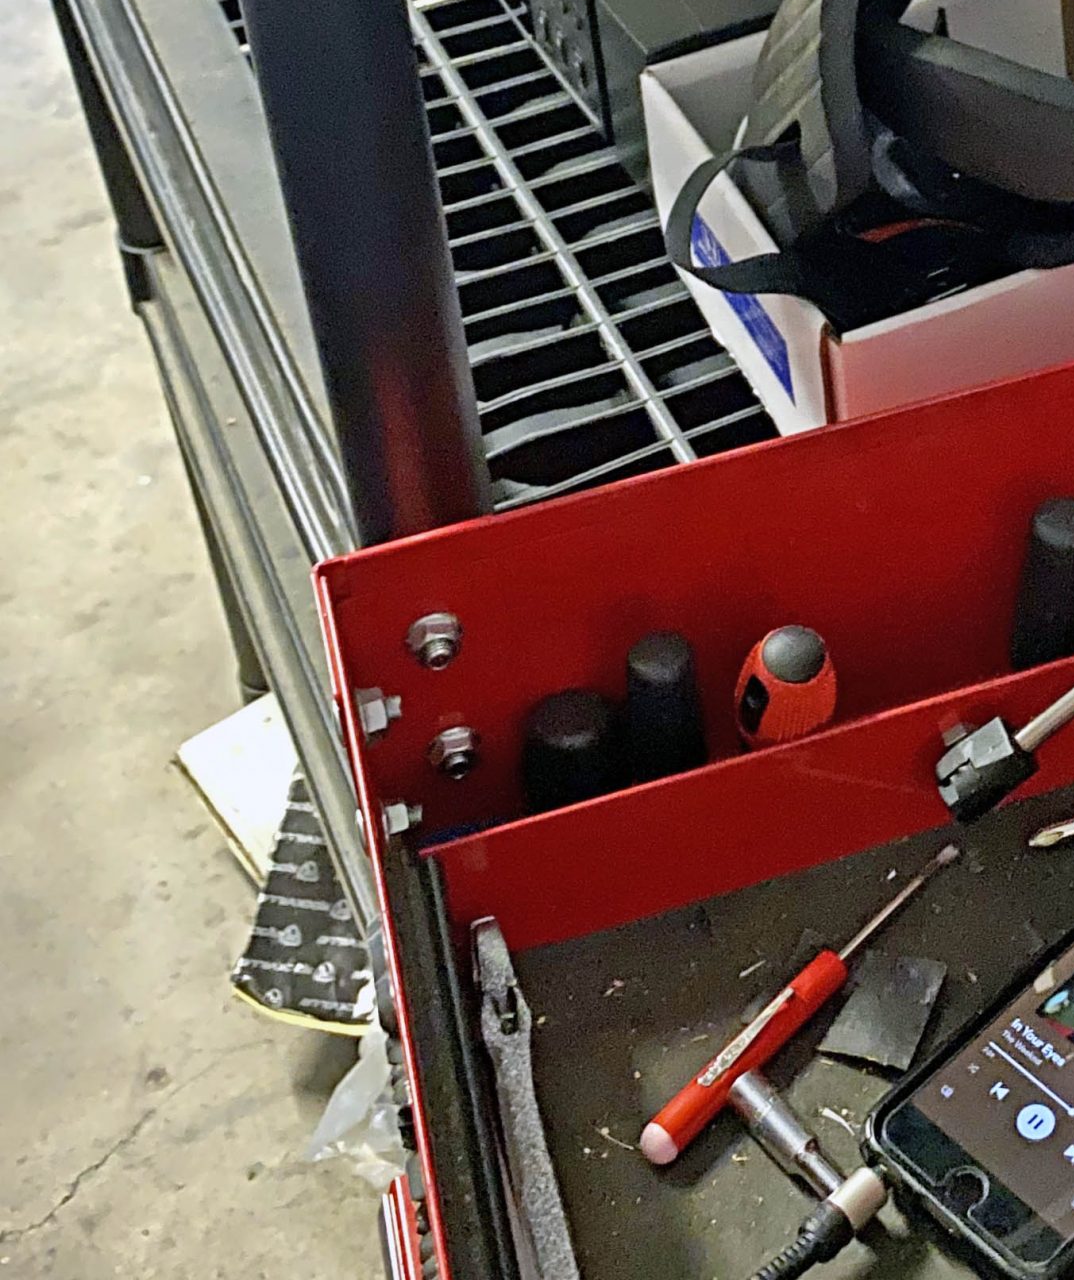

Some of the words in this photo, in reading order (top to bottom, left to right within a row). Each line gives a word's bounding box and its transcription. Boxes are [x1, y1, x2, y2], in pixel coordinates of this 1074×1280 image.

[1011, 1017, 1023, 1033] In
[1022, 1025, 1045, 1048] Your
[1041, 1043, 1066, 1068] Eyes
